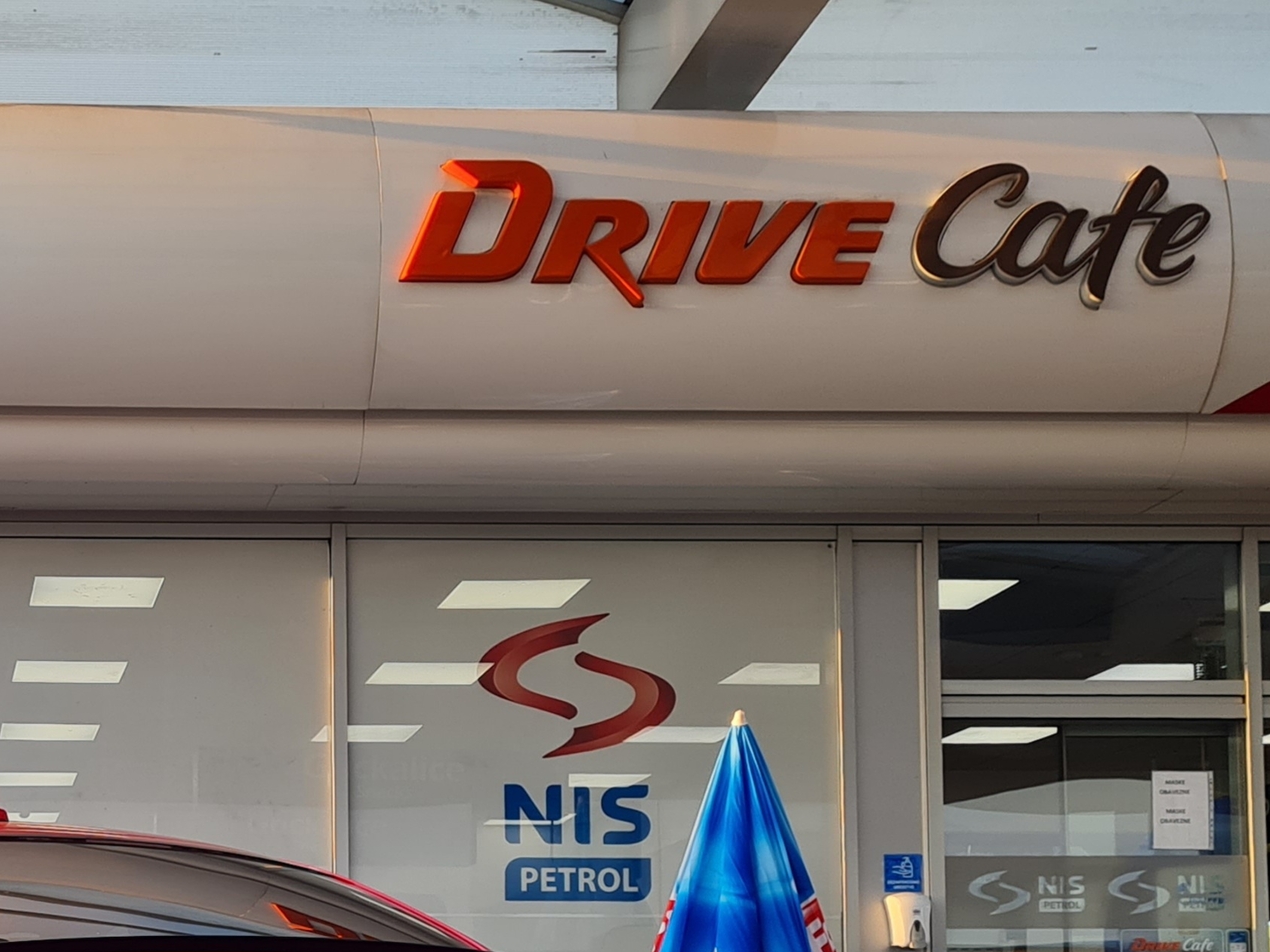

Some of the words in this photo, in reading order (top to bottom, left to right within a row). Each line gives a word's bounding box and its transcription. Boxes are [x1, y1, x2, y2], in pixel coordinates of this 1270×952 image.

[398, 159, 895, 309] DRIVE
[911, 162, 1212, 311] Cafe
[503, 783, 652, 845] NIS
[520, 867, 639, 892] PETROL
[1038, 875, 1085, 895] NIS
[1043, 900, 1082, 910] PETROL
[1182, 938, 1214, 952] Cafe
